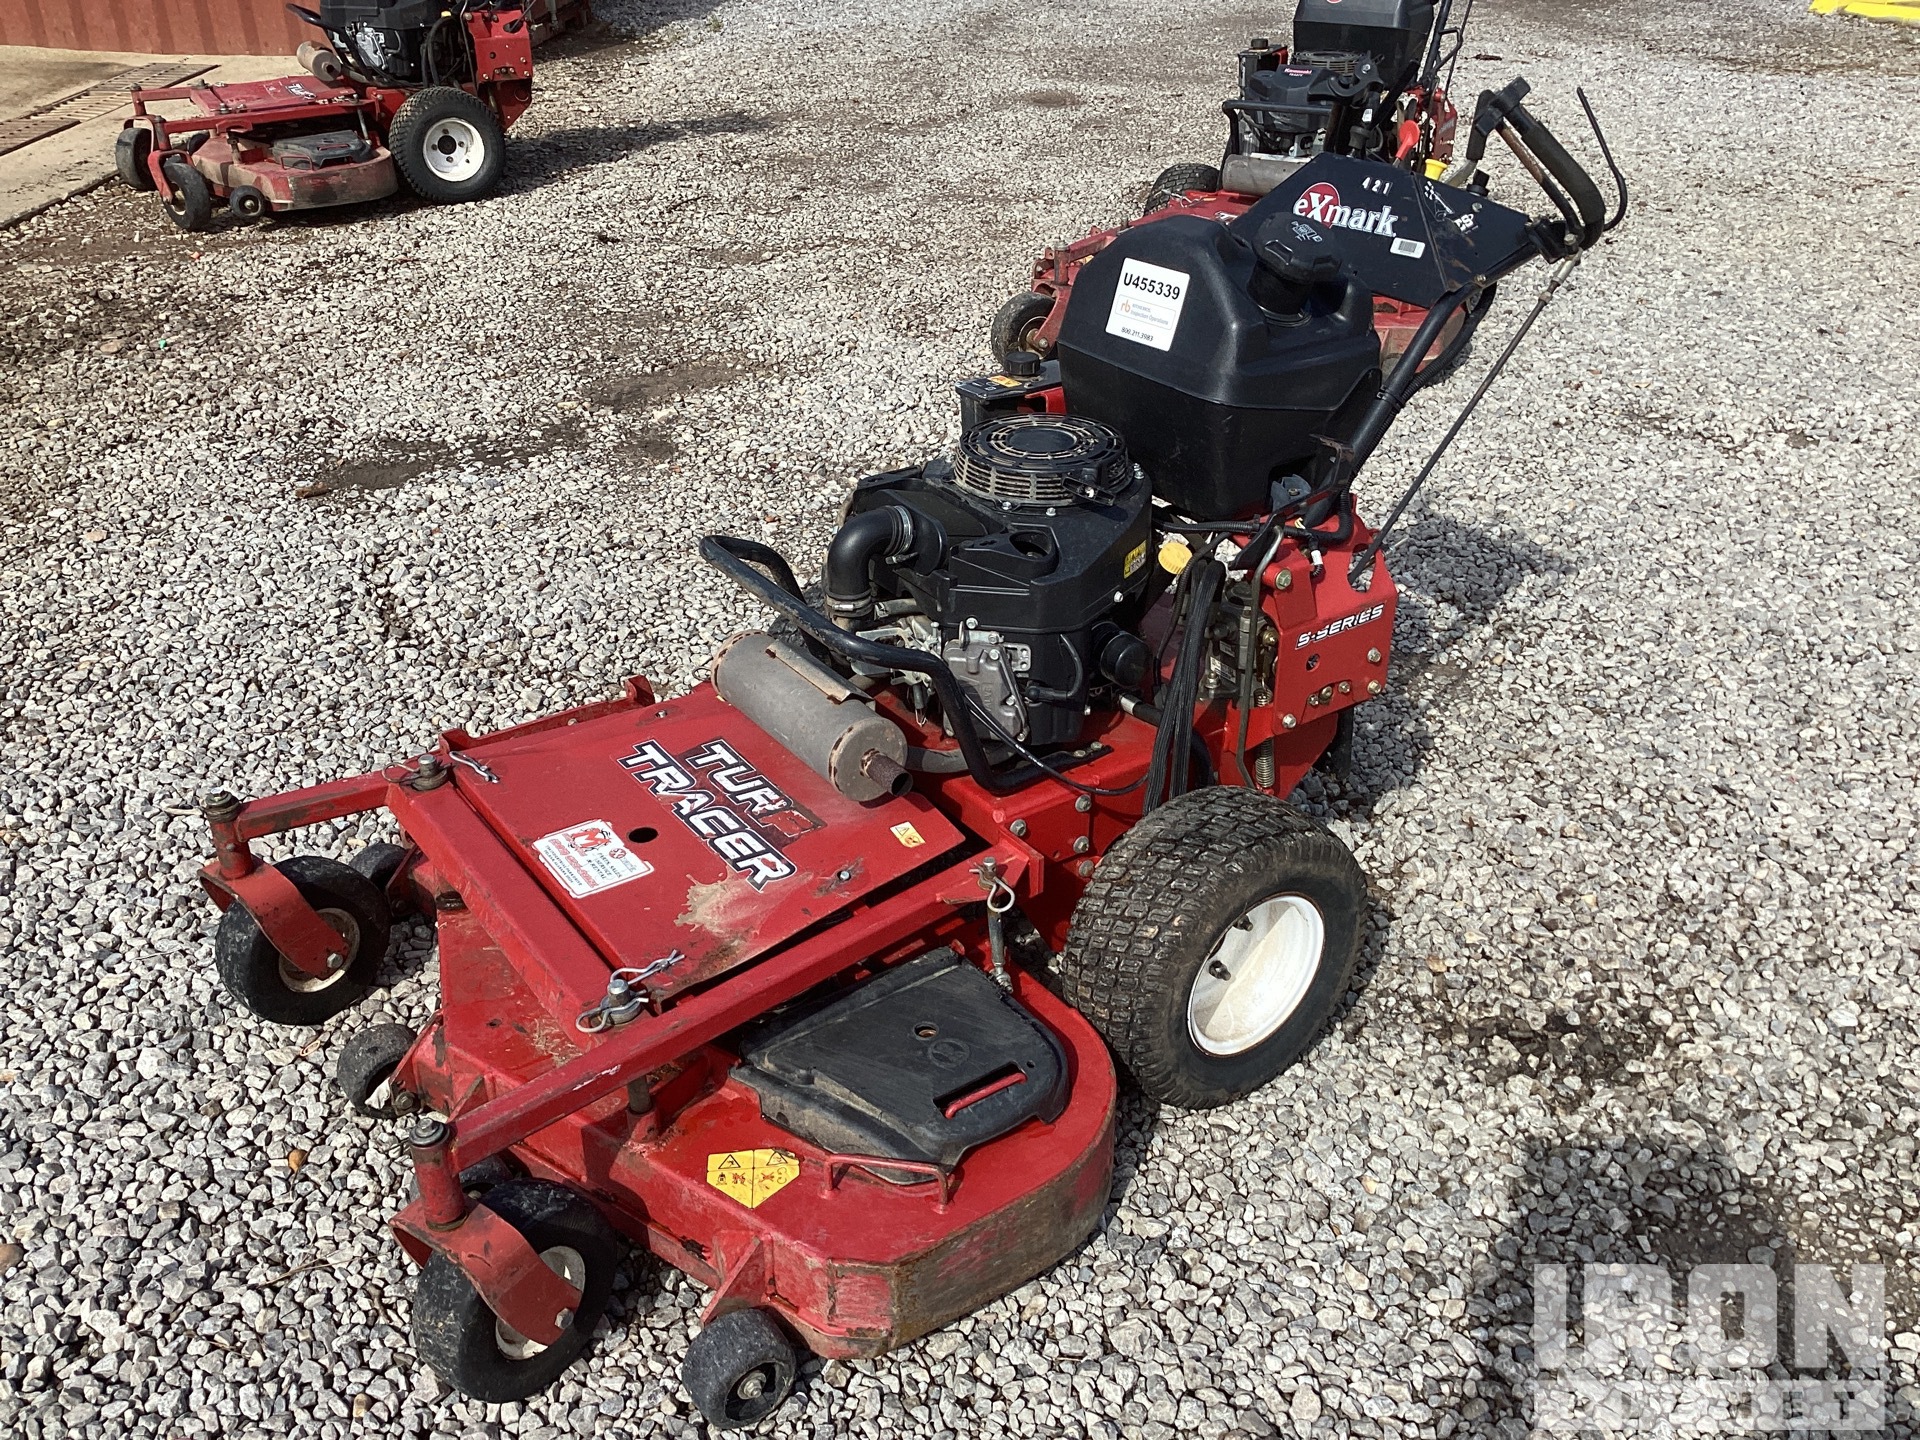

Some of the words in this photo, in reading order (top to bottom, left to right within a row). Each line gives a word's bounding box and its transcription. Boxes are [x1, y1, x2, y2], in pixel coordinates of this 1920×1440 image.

[1362, 177, 1392, 195] 421
[1123, 272, 1180, 300] U455339
[1296, 604, 1384, 648] S-SERIES
[619, 740, 796, 889] TRACER
